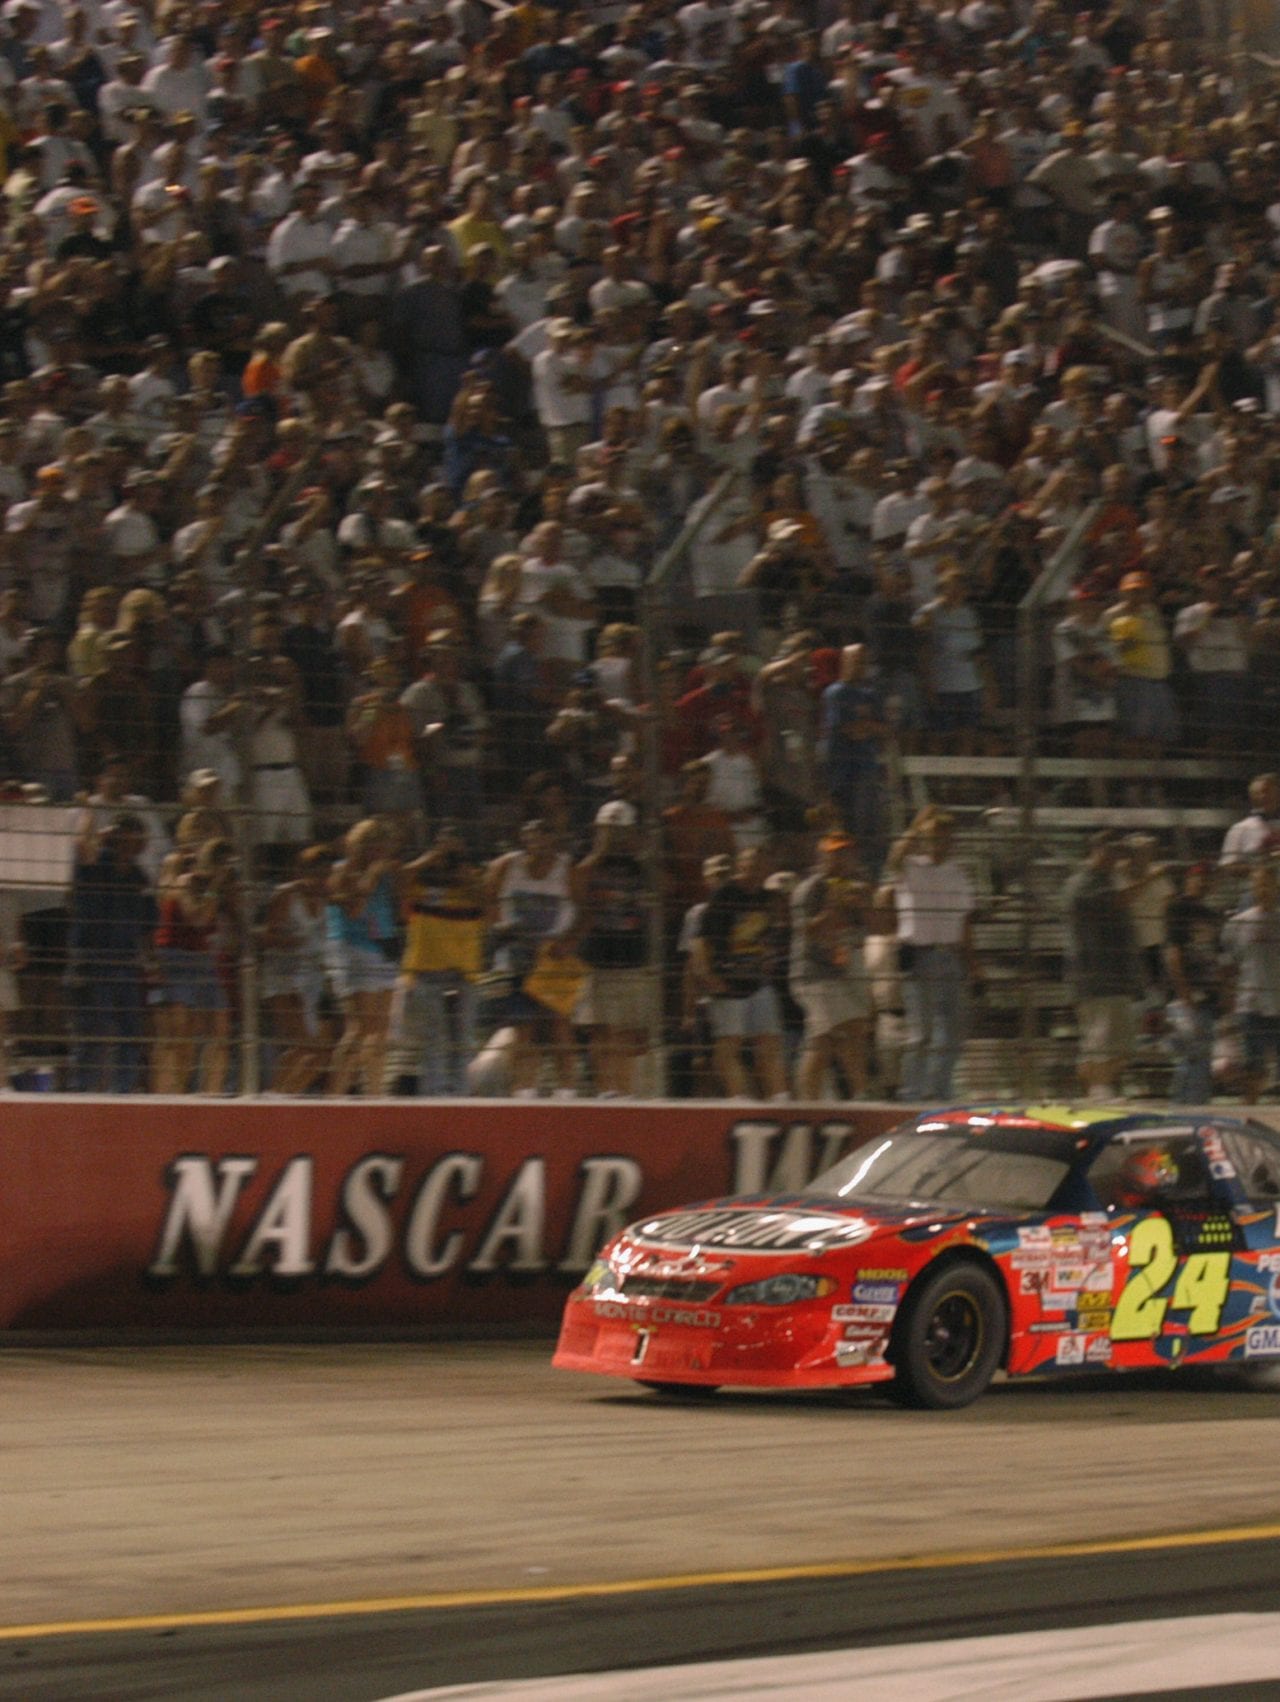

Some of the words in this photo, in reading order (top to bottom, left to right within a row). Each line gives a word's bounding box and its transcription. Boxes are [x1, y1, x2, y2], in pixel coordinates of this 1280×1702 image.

[148, 1154, 643, 1276] NASCAR
[856, 1268, 909, 1281] MOOG
[1023, 1270, 1050, 1292] 3M
[1110, 1217, 1231, 1341] 24
